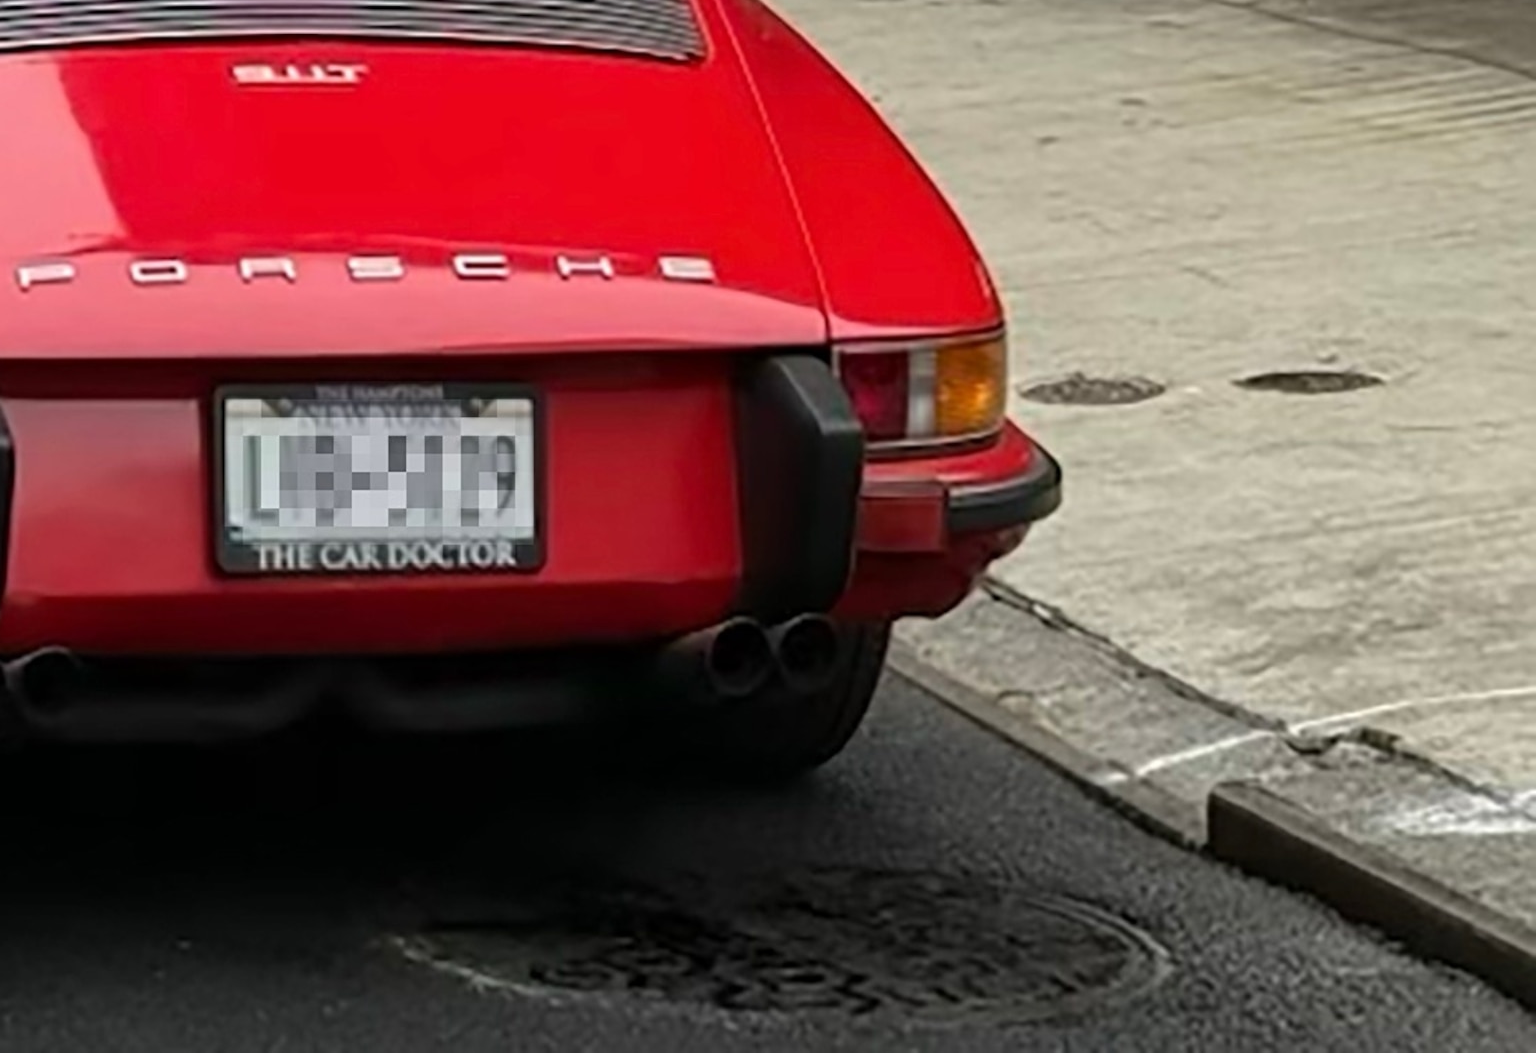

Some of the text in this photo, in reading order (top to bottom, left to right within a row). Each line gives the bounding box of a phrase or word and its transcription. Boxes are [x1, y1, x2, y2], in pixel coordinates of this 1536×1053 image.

[17, 254, 715, 290] PORSCHE
[255, 539, 516, 571] THE CAR DOCTOR
